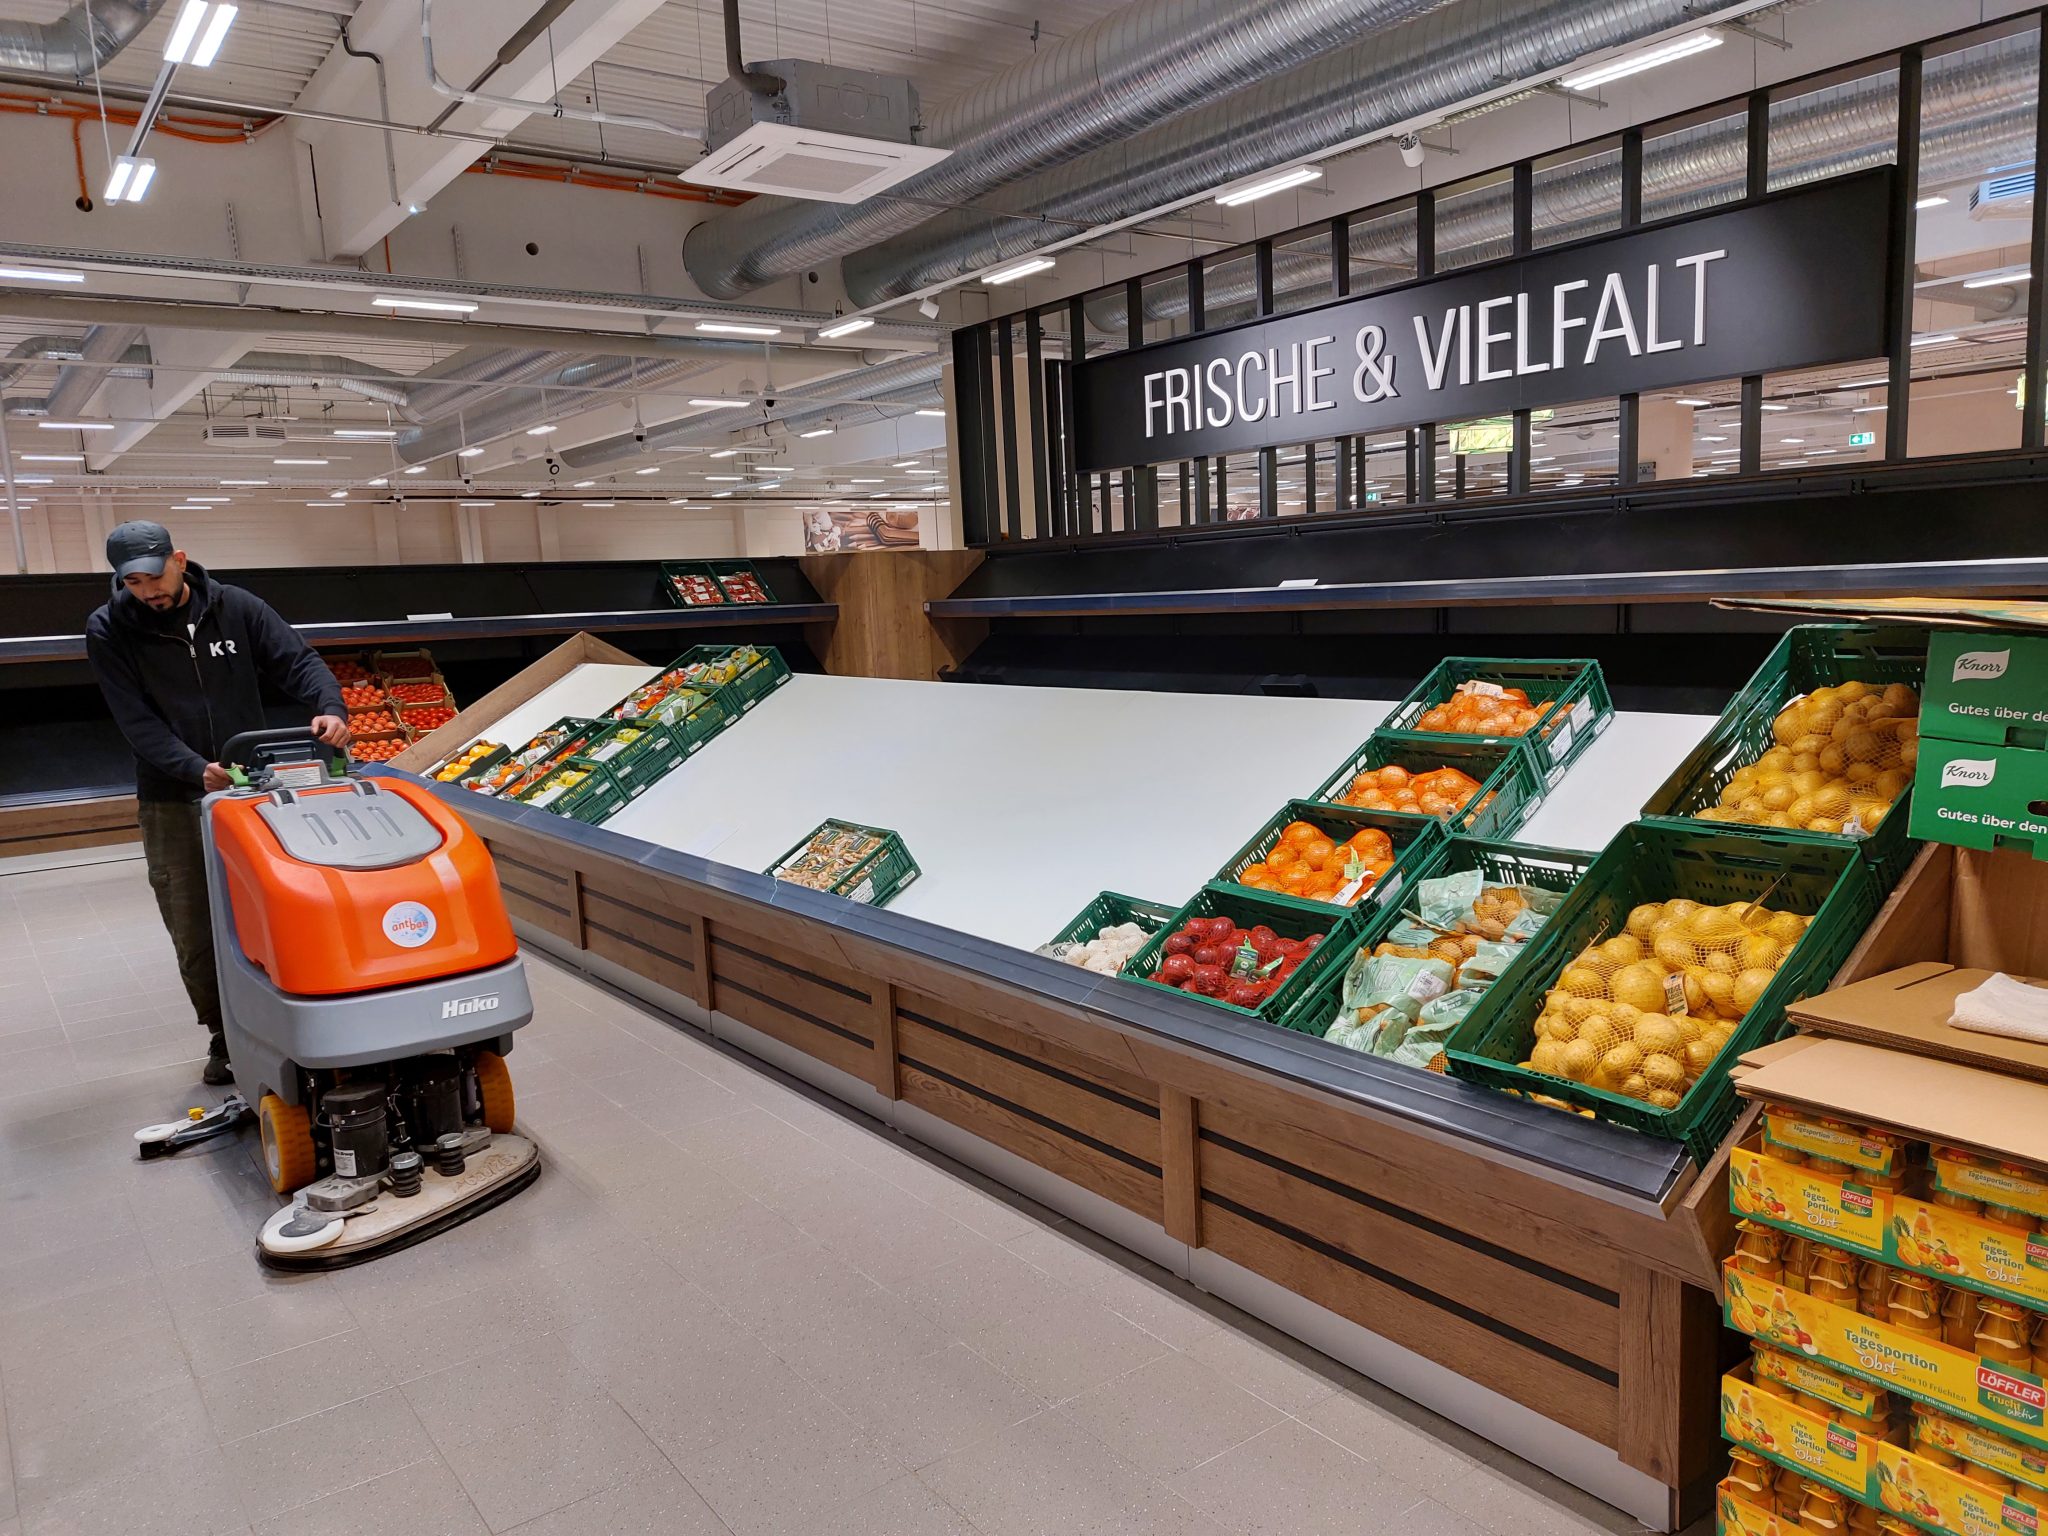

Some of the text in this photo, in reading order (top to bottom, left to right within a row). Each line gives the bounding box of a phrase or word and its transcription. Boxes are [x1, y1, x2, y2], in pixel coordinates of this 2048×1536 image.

[1144, 249, 1728, 437] FRISCHE & VIELFALT
[209, 640, 238, 657] KR
[1957, 658, 2003, 673] Knorr
[1948, 702, 1990, 717] Gutes
[1994, 706, 2029, 721] über
[1946, 765, 1990, 781] Knorr
[1937, 807, 2048, 834] Gutes über den
[441, 992, 500, 1019] Hako
[1802, 1189, 1830, 1204] Tages-
[1841, 1192, 1874, 1206] LÖFFLER
[1807, 1200, 1840, 1216] portion
[1804, 1210, 1841, 1229] Obst
[1979, 1241, 2012, 1257] Tages-
[1985, 1253, 2025, 1271] portion
[1982, 1265, 2026, 1286] Obst
[1861, 1326, 1880, 1338] Ihre
[1844, 1329, 1938, 1373] Tagesportion
[1857, 1350, 1967, 1403] Obst aus 10 Früchten
[1980, 1372, 2041, 1403] LÖFFLER
[1987, 1391, 2020, 1410] Frucht
[2007, 1408, 2037, 1420] aktiv
[1794, 1436, 1826, 1455] portion
[1827, 1432, 1857, 1449] LÖFFLER
[1966, 1432, 2017, 1459] Tagesportion
[1793, 1447, 1826, 1467] Obst
[1963, 1509, 2000, 1530] portion
[2002, 1507, 2036, 1526] LÖFFLER
